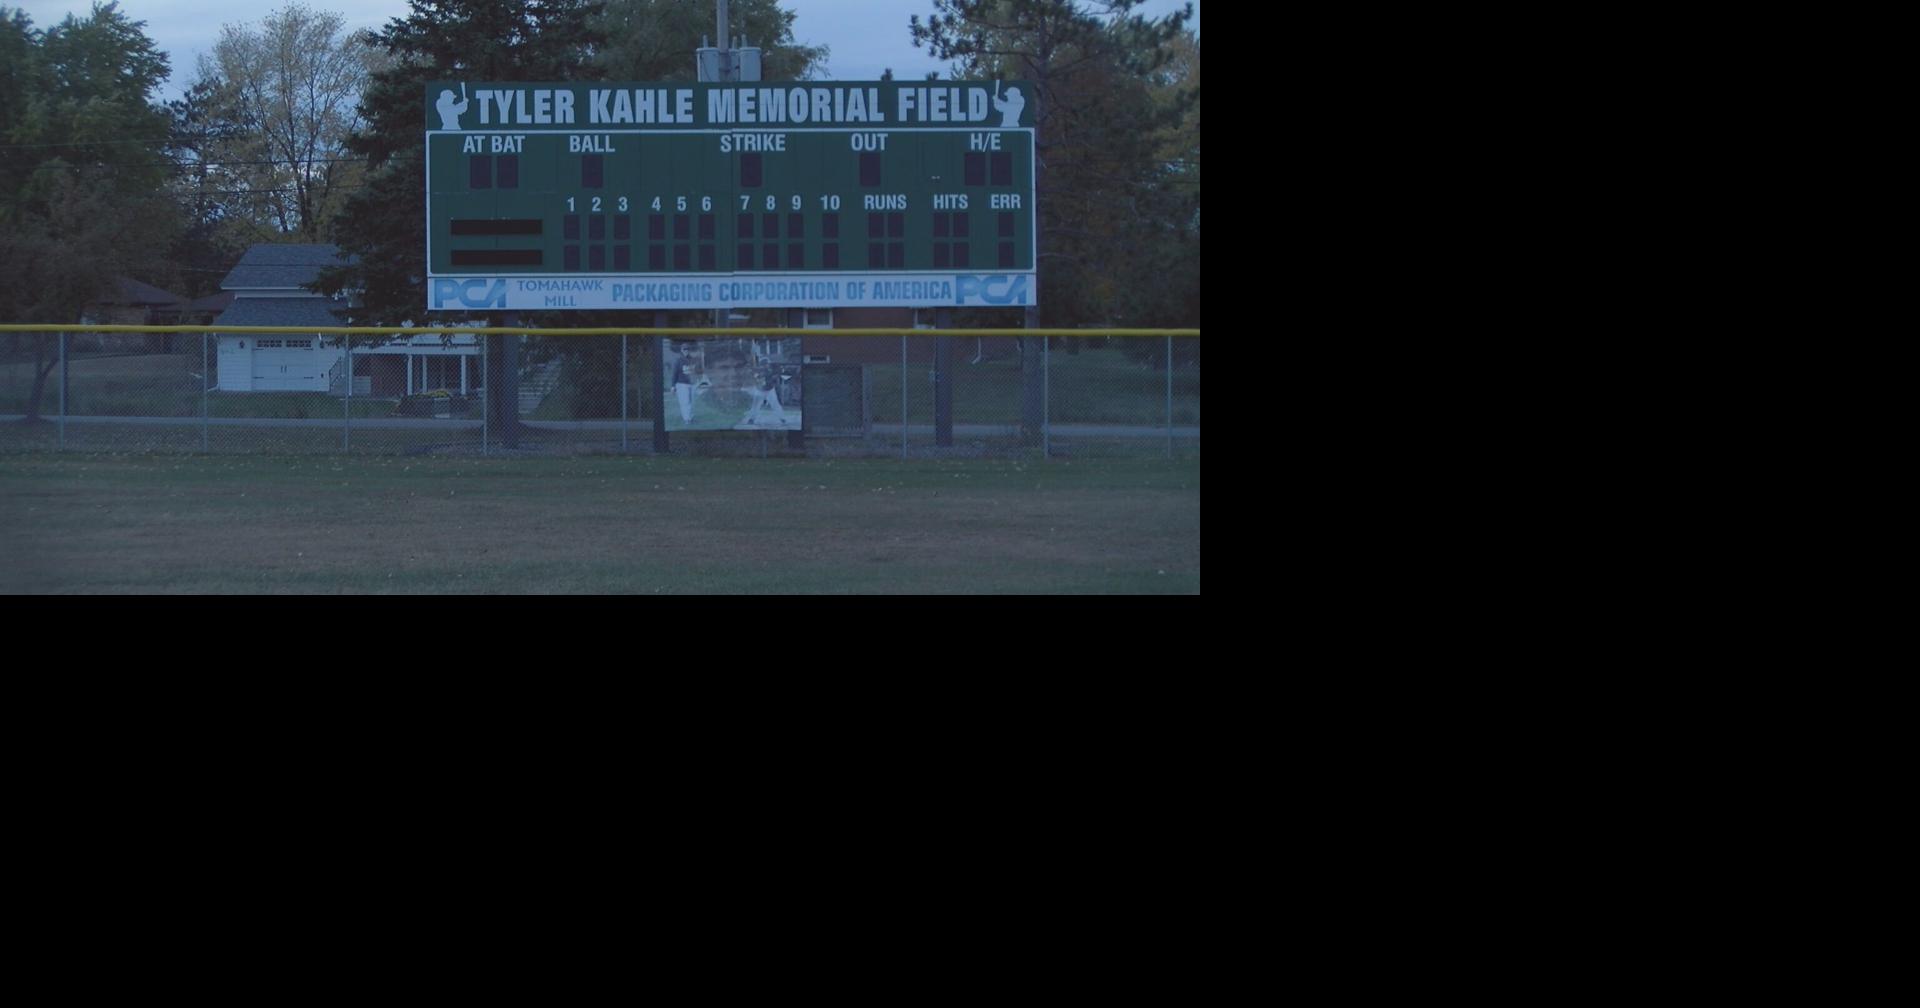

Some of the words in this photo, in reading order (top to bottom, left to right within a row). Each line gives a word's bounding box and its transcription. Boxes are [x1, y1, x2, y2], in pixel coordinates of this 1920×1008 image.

[475, 89, 575, 125] TYLER
[589, 89, 693, 124] KAHLE
[707, 87, 885, 124] MEMORIAL
[898, 87, 988, 121] FIELD
[463, 136, 485, 153] AT
[491, 136, 525, 153] BAT
[569, 135, 615, 153] BALL
[720, 134, 786, 152] STRIKE
[851, 133, 888, 151] OUT
[970, 133, 1001, 152] H/E
[567, 197, 575, 212] 1
[592, 197, 601, 212] 2
[618, 197, 628, 212] 3
[652, 197, 661, 211] 4
[677, 197, 687, 211] 5
[702, 197, 712, 211] 6
[740, 195, 750, 211] 7
[766, 195, 776, 210] 8
[792, 195, 802, 210] 9
[820, 195, 841, 210] 10
[864, 195, 907, 210] RUNS
[934, 194, 969, 209] HITS
[991, 194, 1021, 209] ERR
[517, 280, 604, 291] TOMAHAWK
[612, 283, 712, 302] PACKAGING
[719, 281, 839, 301] CORPORATION
[846, 281, 866, 300] OF
[872, 280, 952, 300] AMERICA
[544, 296, 577, 307] MILL
